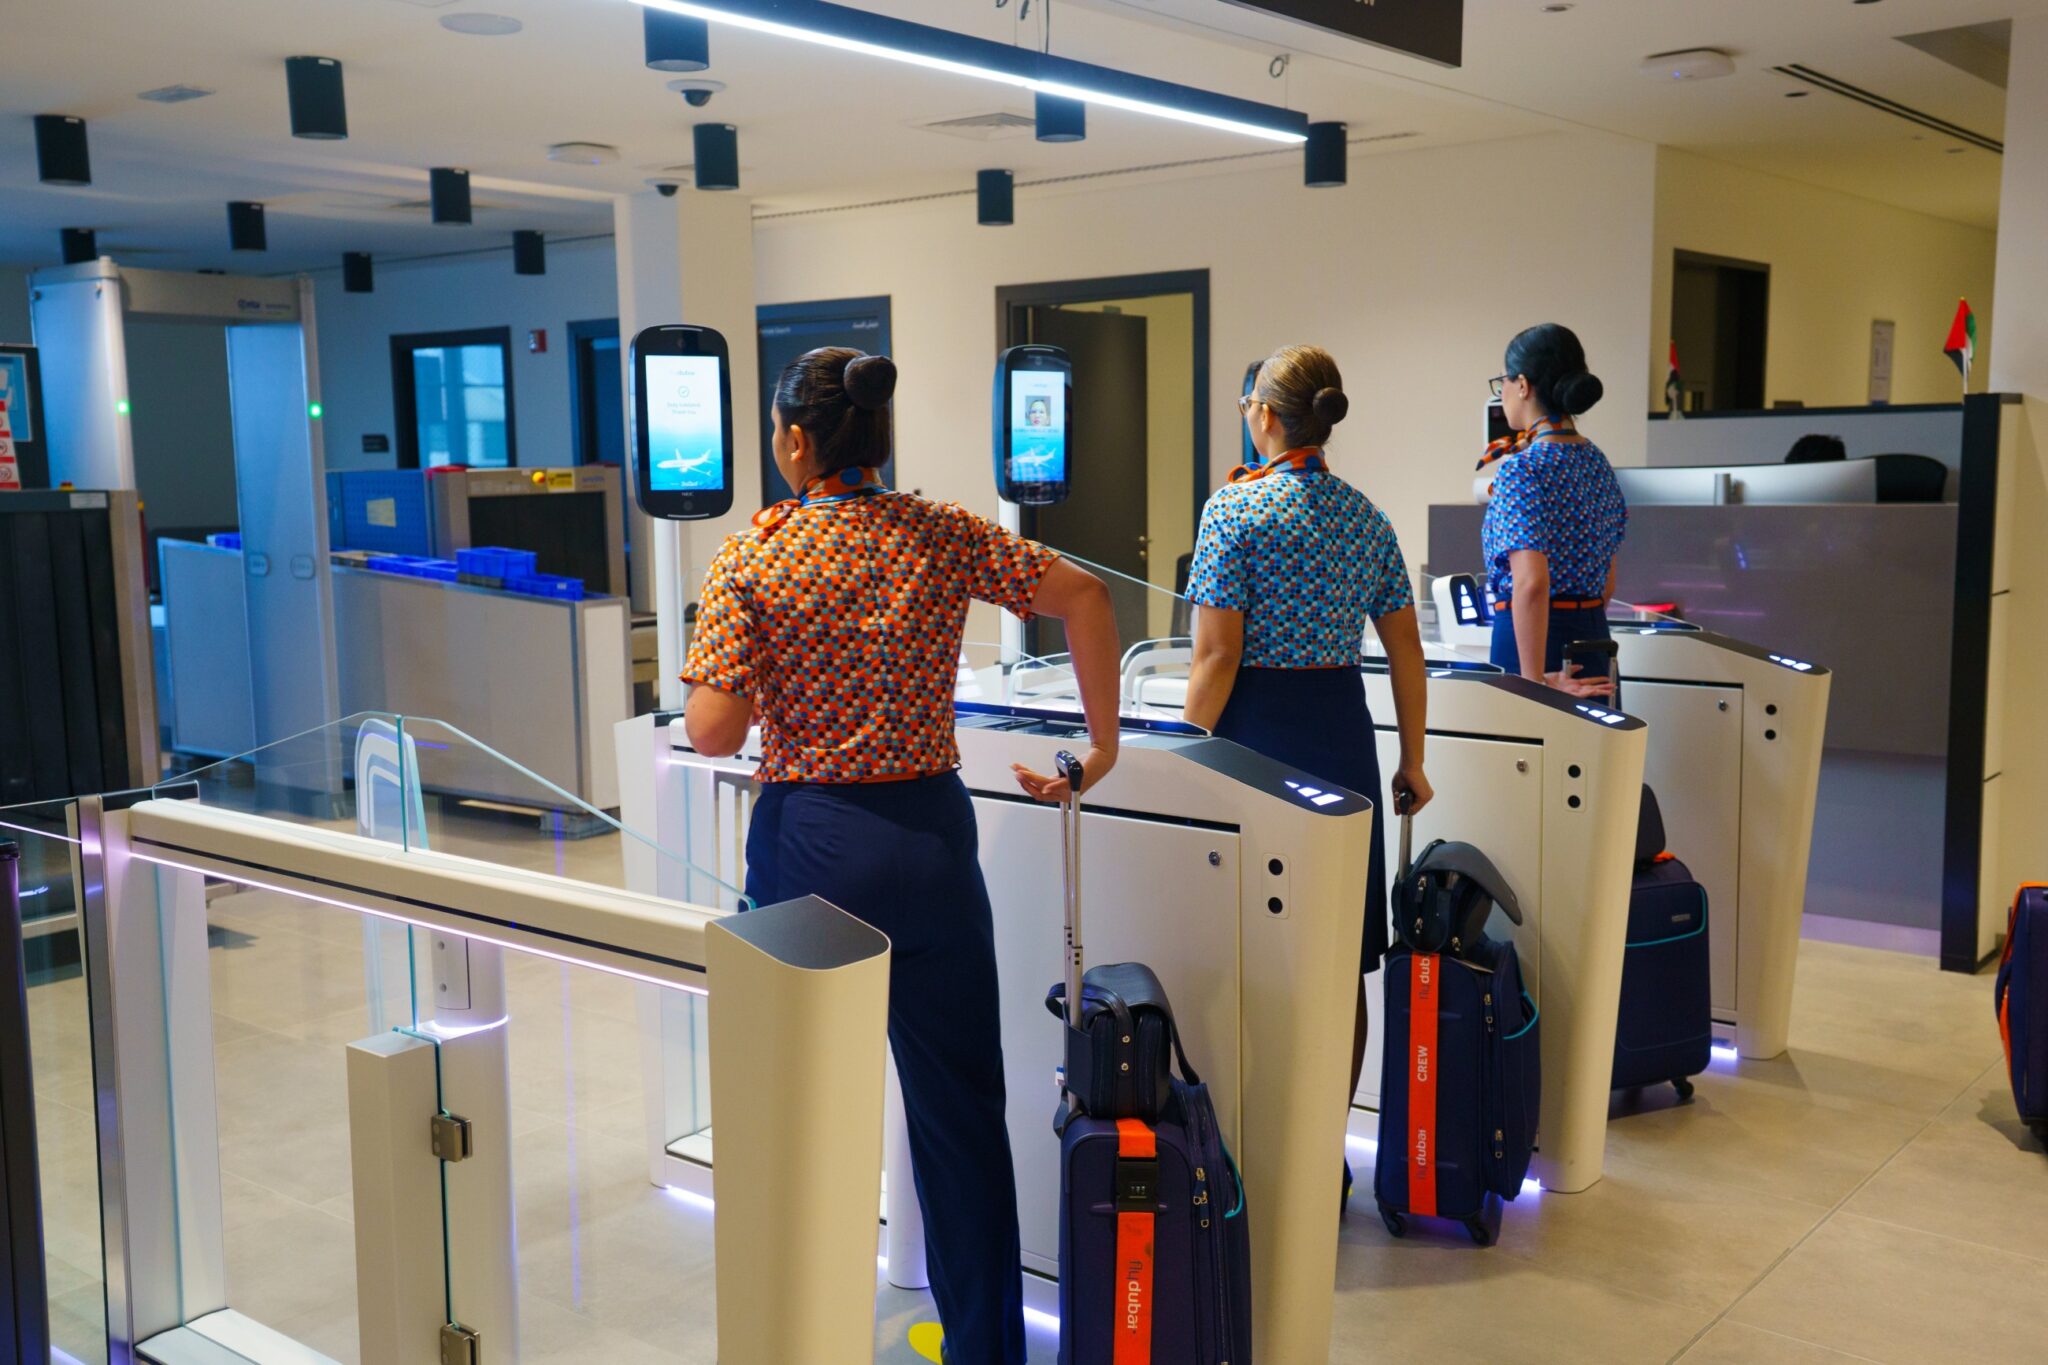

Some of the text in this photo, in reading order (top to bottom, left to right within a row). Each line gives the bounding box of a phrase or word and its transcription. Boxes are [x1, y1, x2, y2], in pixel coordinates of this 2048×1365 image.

[1418, 955, 1431, 1000] flydub
[1417, 1045, 1429, 1083] CREW
[1126, 1260, 1144, 1331] flydubai
